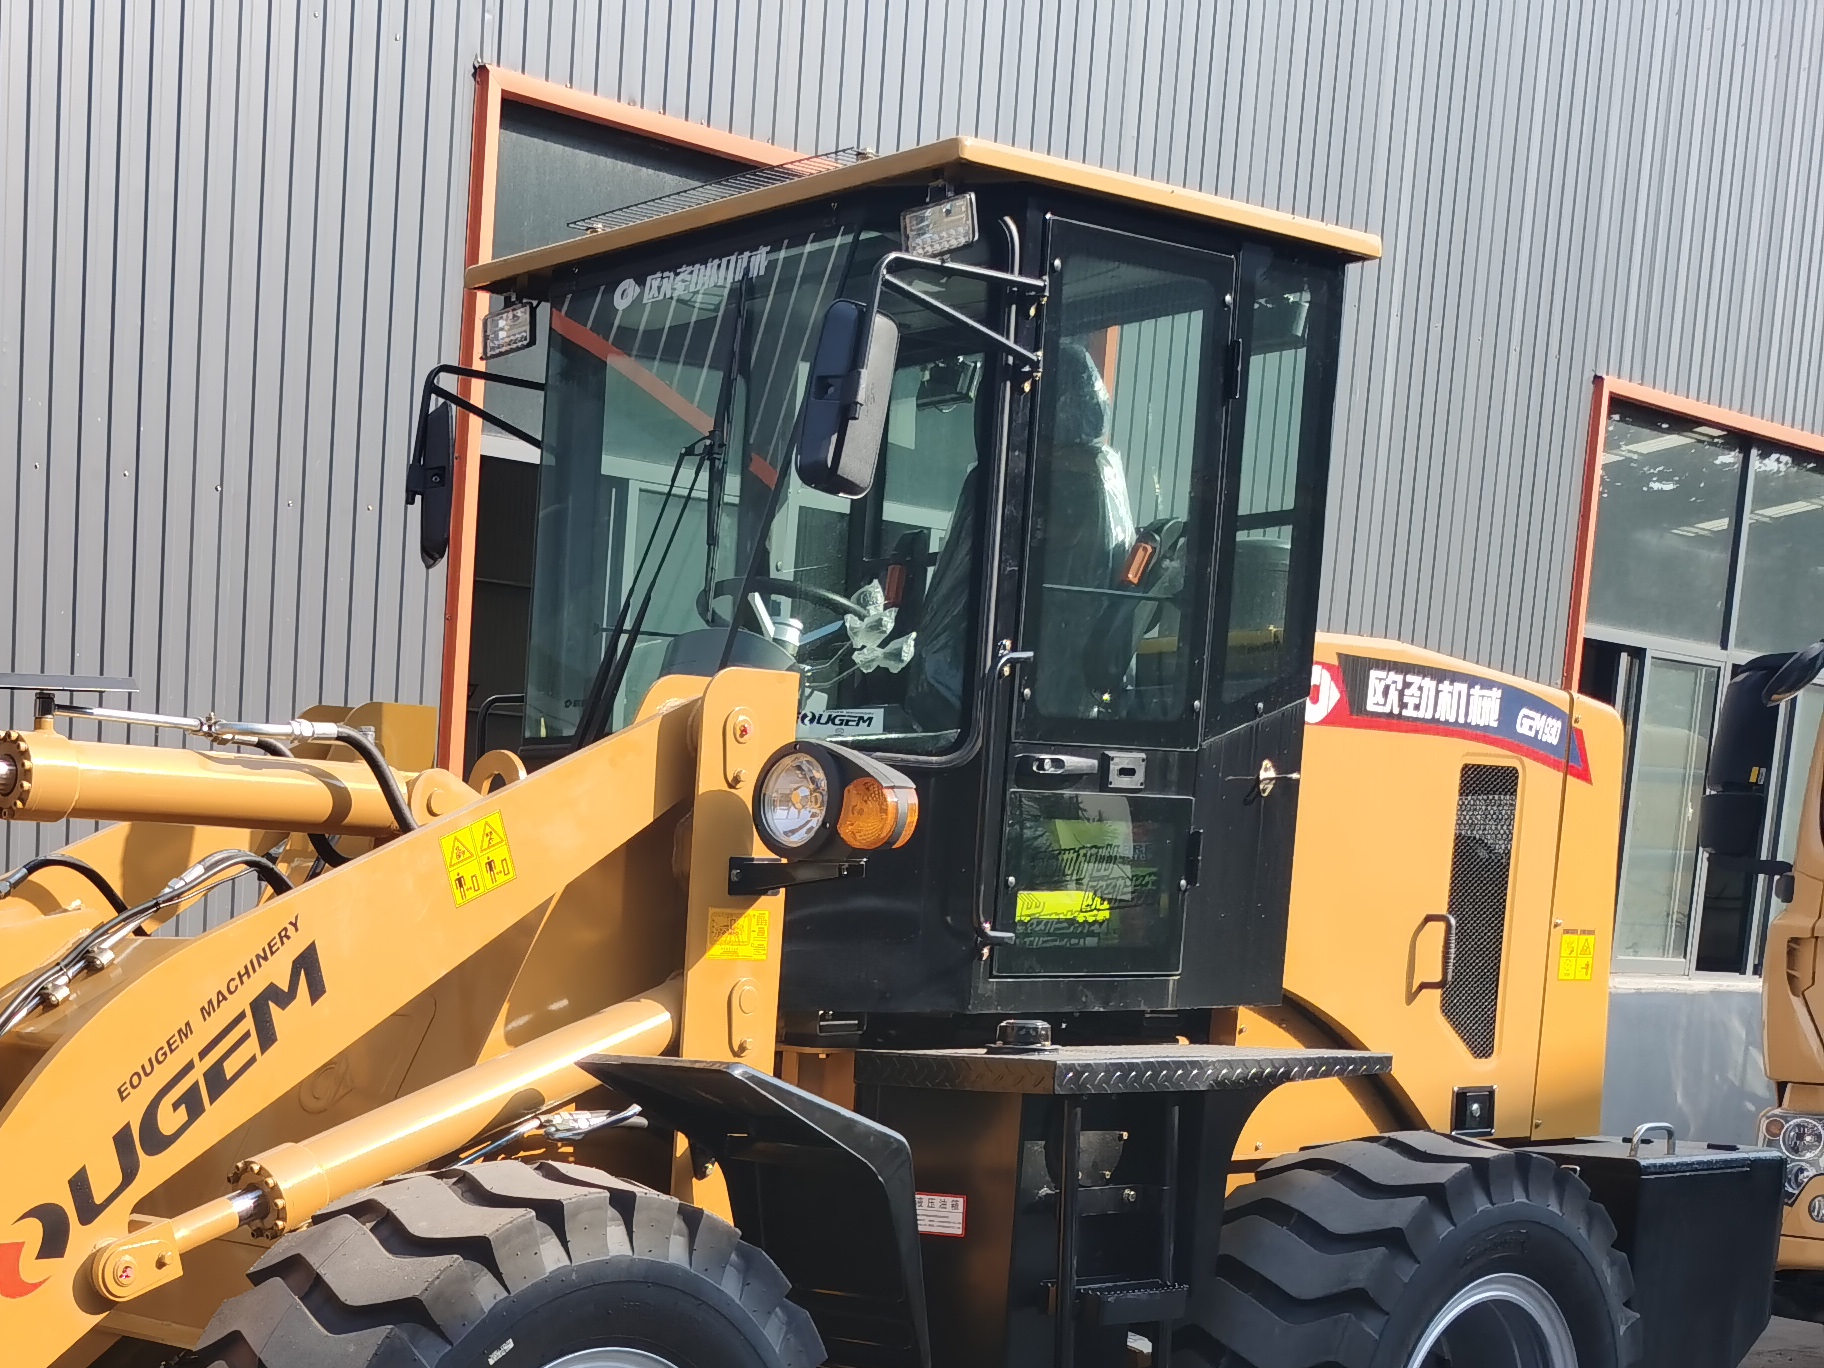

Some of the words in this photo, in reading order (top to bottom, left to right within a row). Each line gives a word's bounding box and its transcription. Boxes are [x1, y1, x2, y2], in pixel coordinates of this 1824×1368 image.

[797, 711, 874, 727] OUGEM
[1366, 669, 1503, 728] 欧劲机械
[116, 1020, 194, 1103] EOUGEM
[199, 913, 300, 1022] MACHINERY
